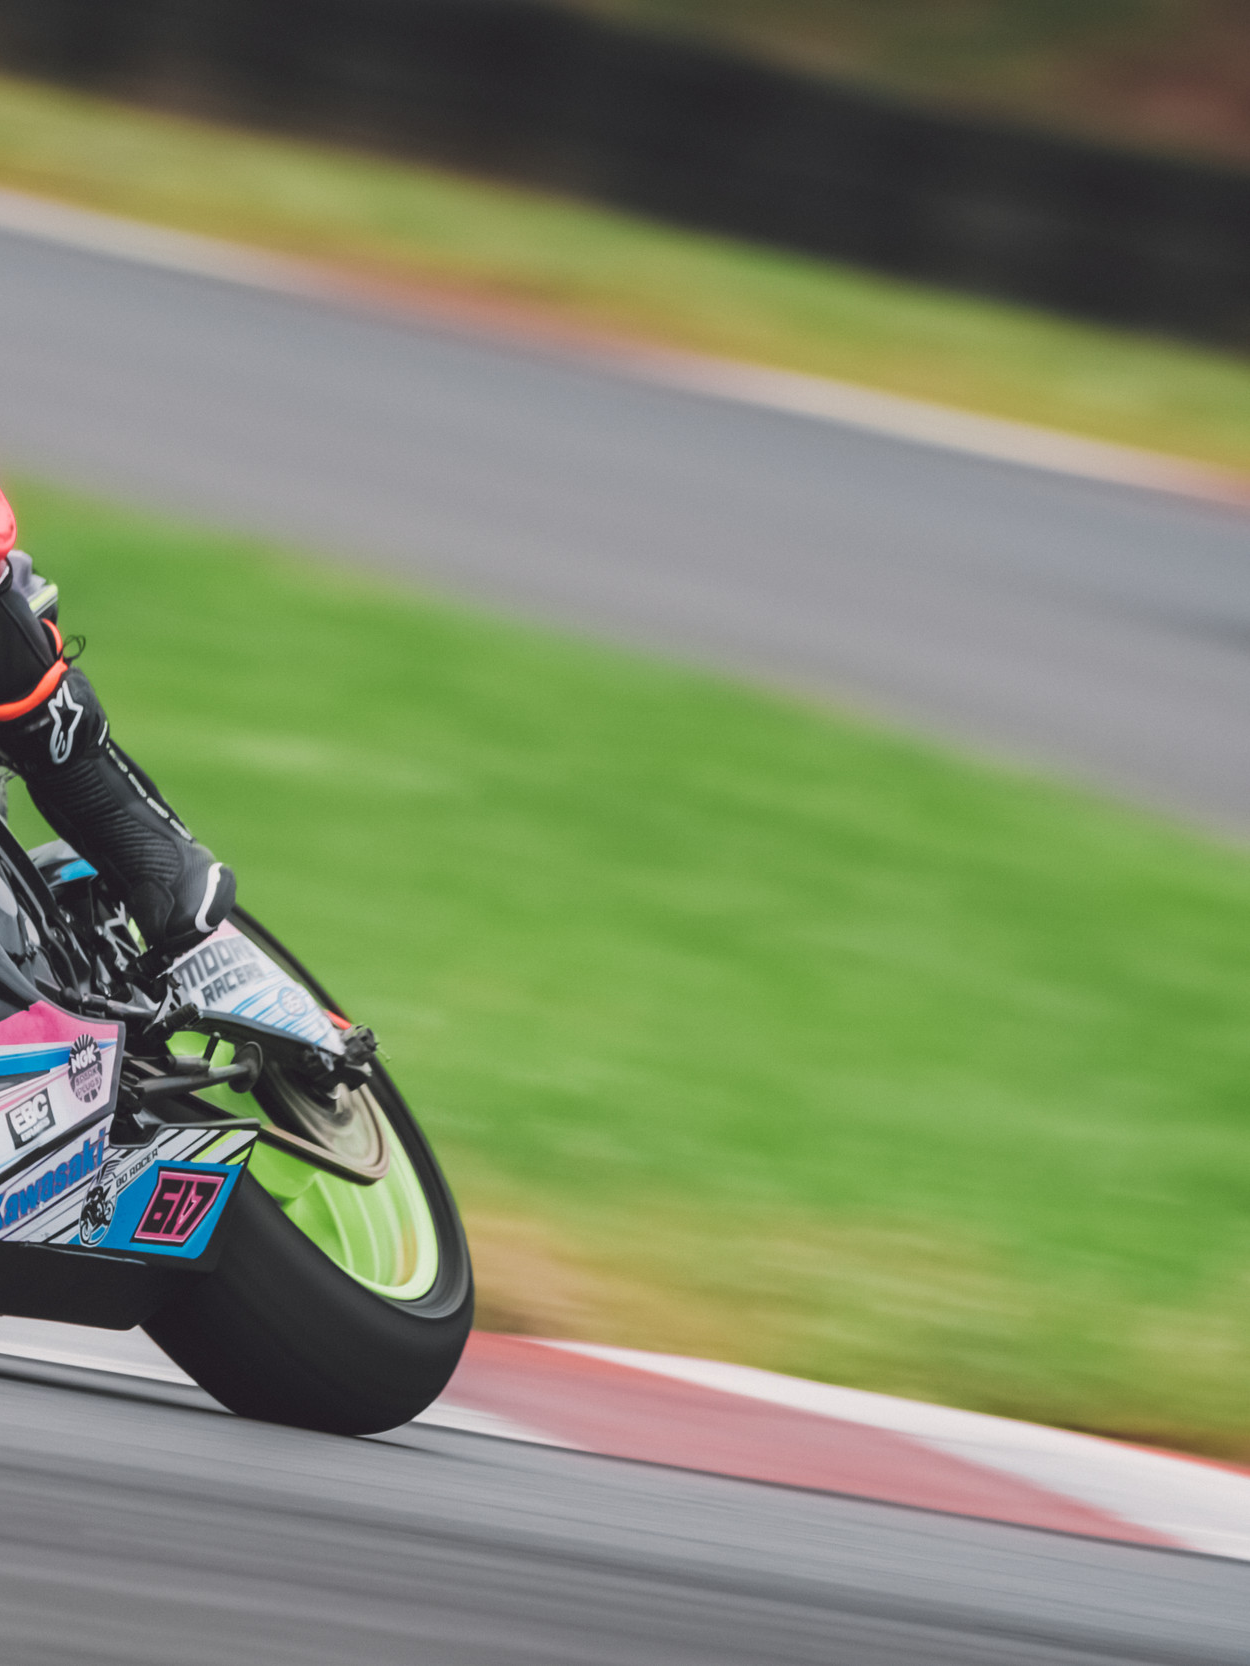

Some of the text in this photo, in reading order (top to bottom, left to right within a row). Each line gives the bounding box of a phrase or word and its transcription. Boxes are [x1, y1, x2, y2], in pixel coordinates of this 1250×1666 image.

[70, 1043, 97, 1074] NGK
[9, 1093, 49, 1135] EBC
[140, 1177, 219, 1236] 617
